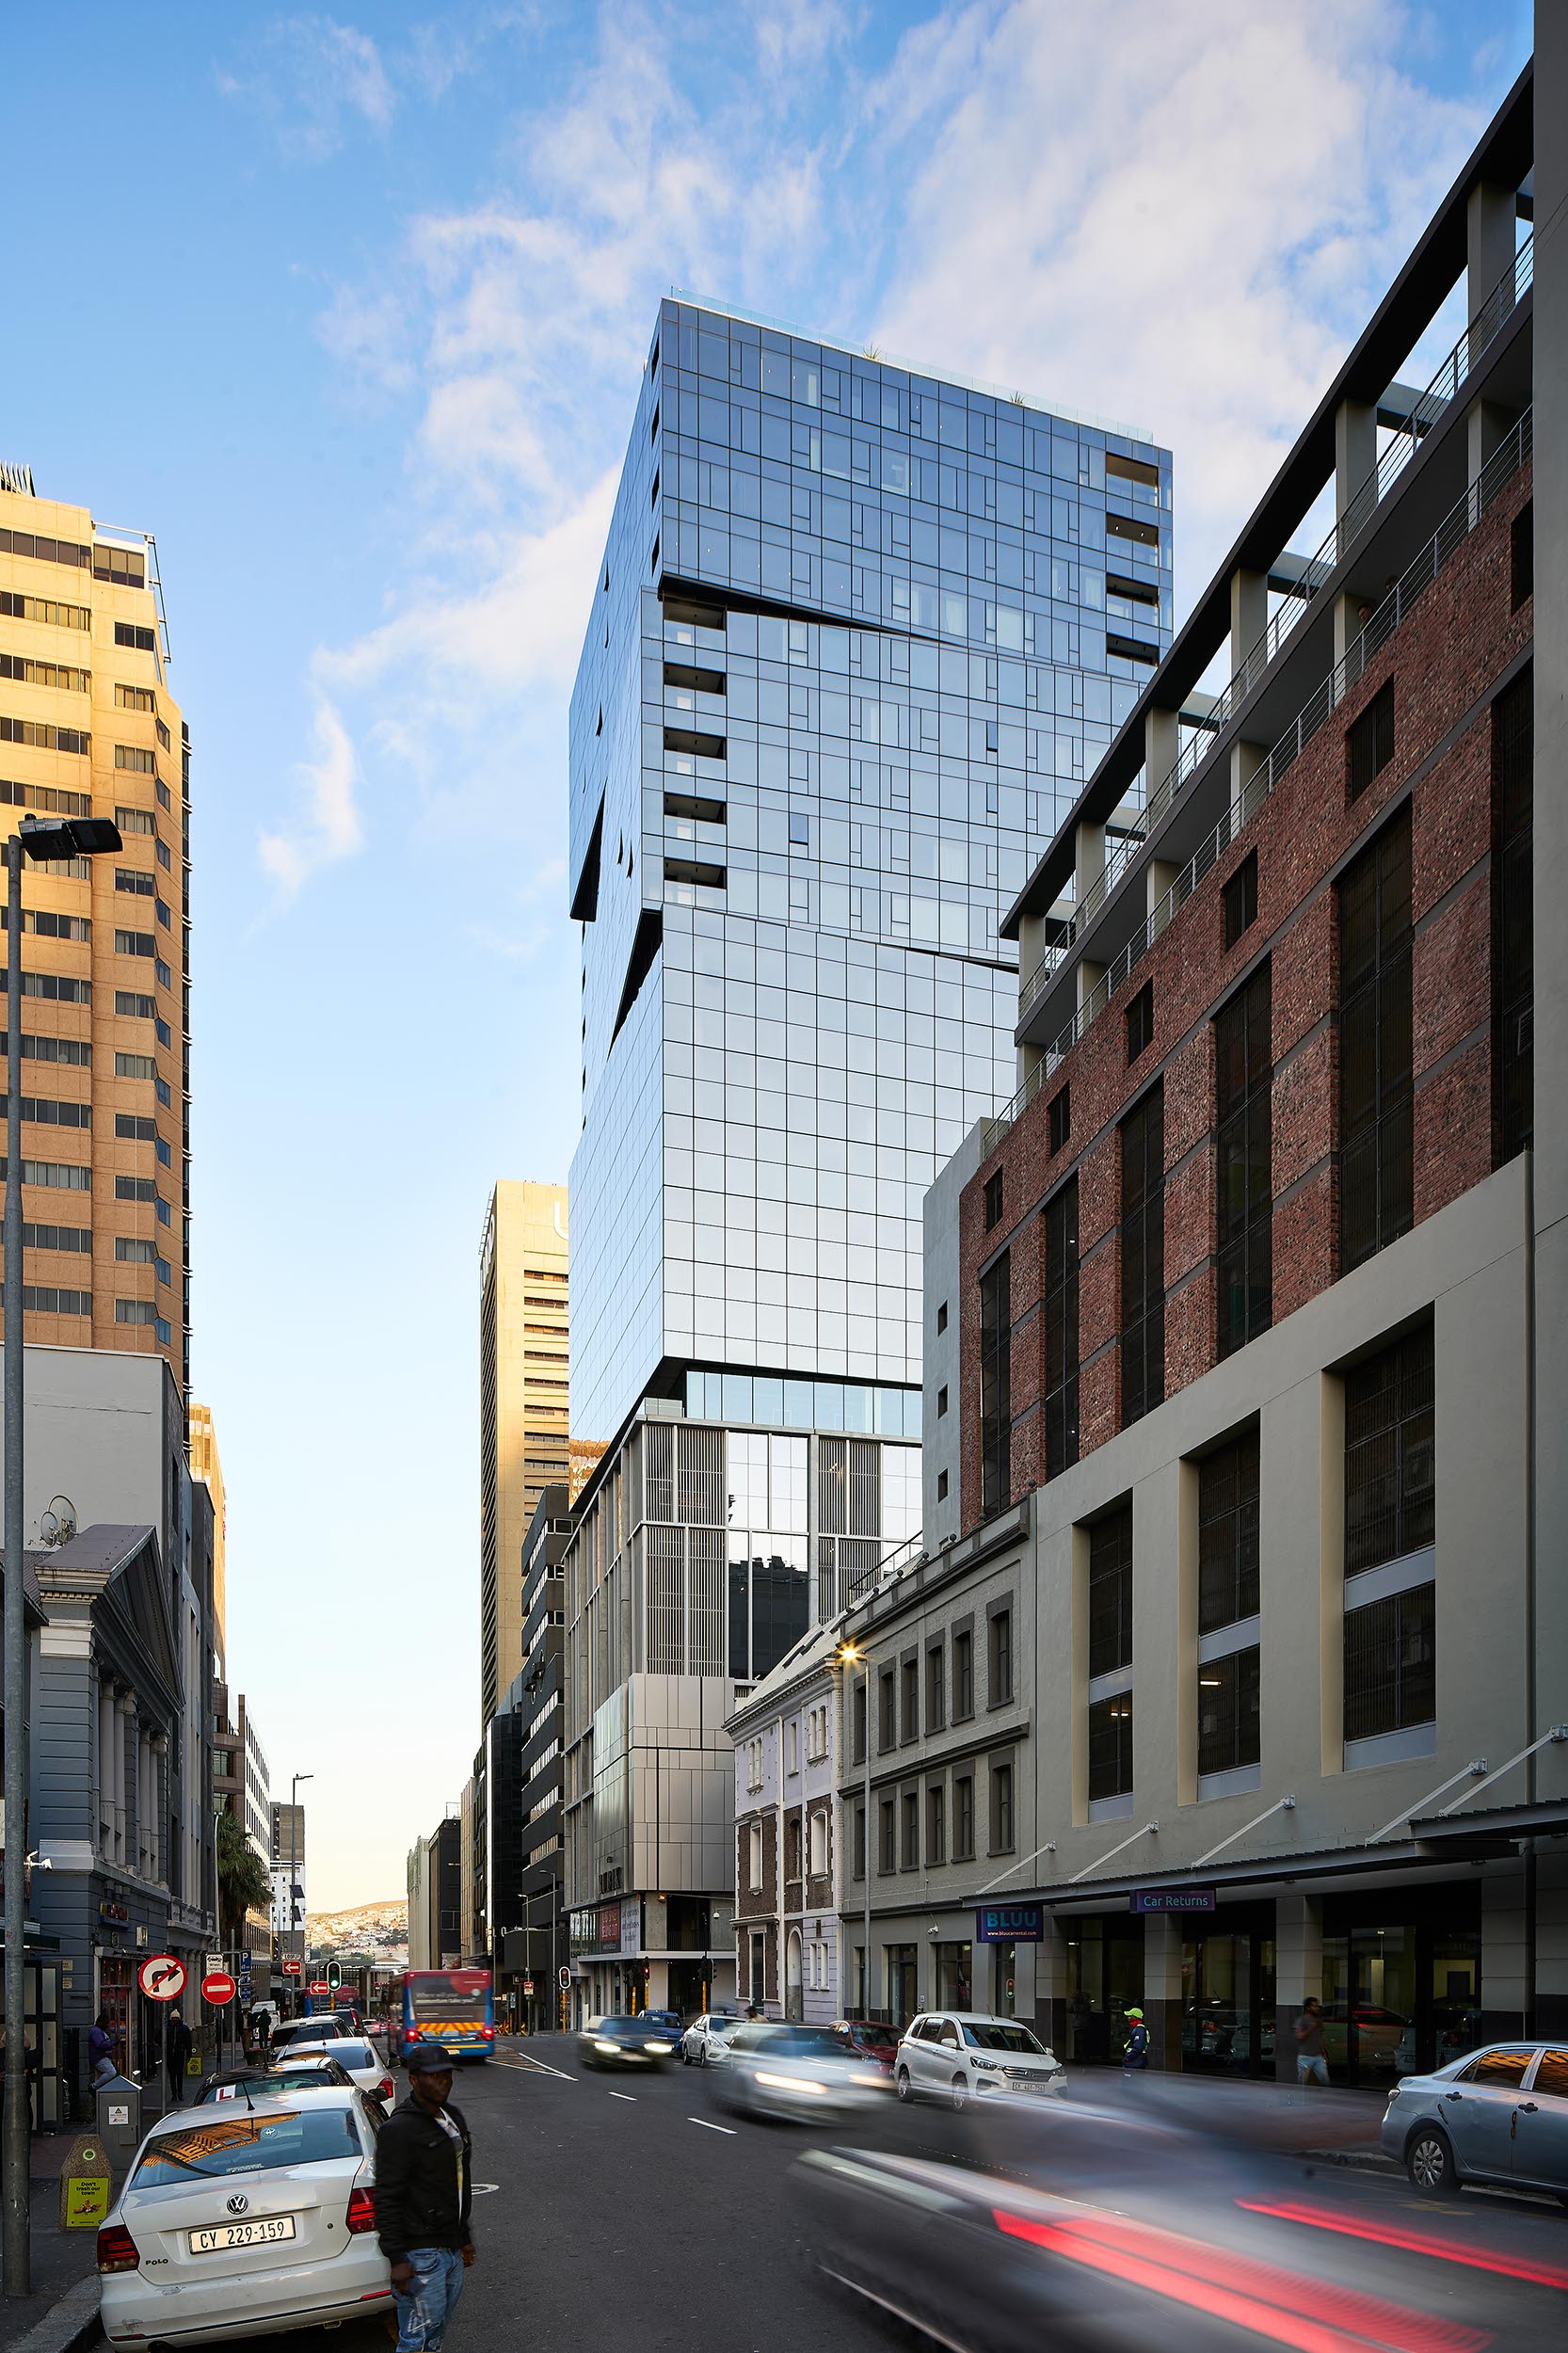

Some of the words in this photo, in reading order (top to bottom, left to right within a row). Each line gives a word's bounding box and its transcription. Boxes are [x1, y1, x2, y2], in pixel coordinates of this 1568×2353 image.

[1144, 1896, 1162, 1907] Car
[1165, 1896, 1208, 1906] Returns
[986, 1912, 1037, 1928] BLUU
[242, 1952, 248, 1961] P
[219, 2089, 232, 2100] L
[200, 2233, 217, 2249] CY
[227, 2221, 284, 2245] 229-159
